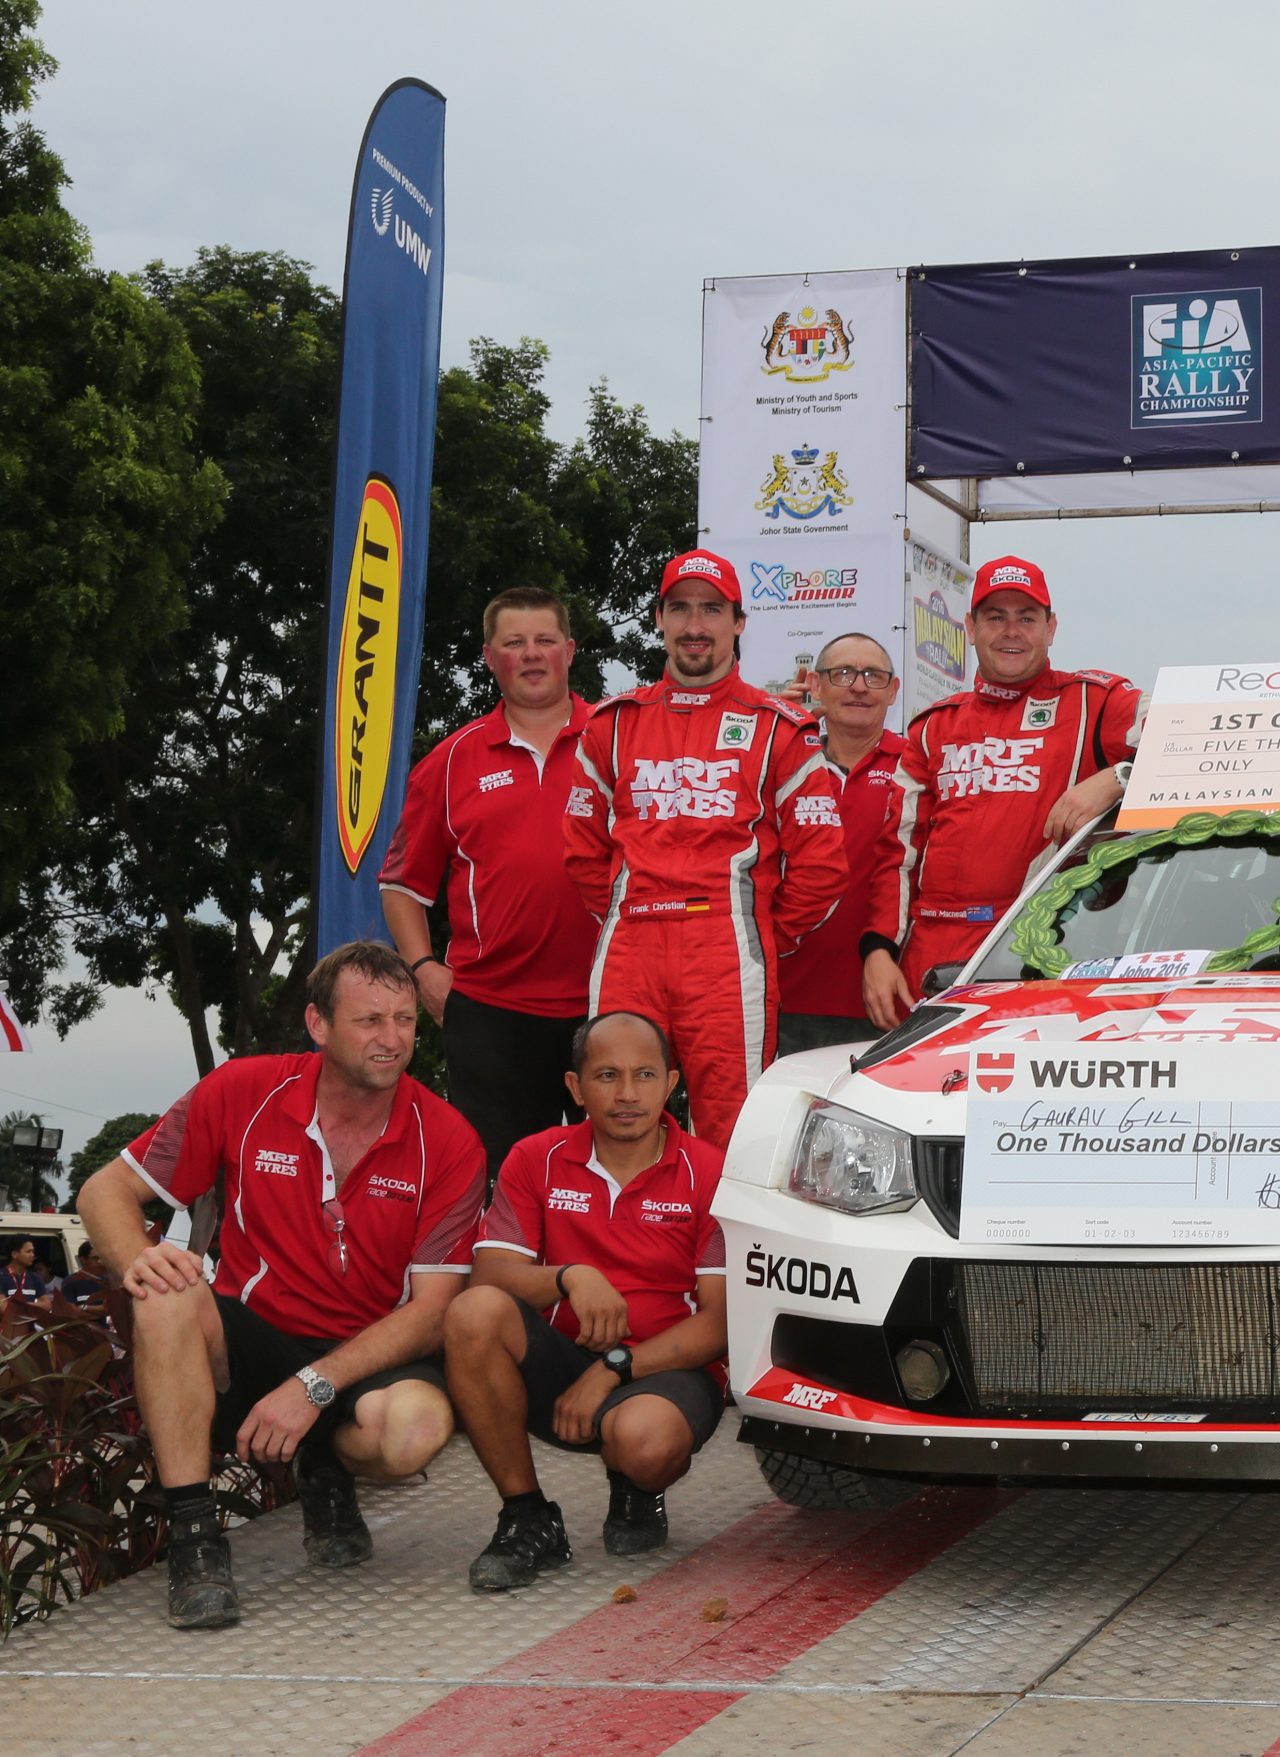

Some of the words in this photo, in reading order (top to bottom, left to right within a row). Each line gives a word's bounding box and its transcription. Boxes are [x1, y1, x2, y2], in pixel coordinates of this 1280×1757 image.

[372, 147, 401, 185] PREMIUM
[401, 173, 425, 210] PRODUCT
[394, 213, 432, 276] UMW
[1142, 354, 1252, 372] ASIA-PACIFIC
[1139, 367, 1254, 399] RALLY
[756, 395, 785, 405] Ministry
[787, 394, 794, 403] of
[795, 393, 817, 403] Youth
[818, 393, 834, 401] and
[834, 391, 858, 403] Sports
[1140, 394, 1250, 411] CHAMPIONSHIP
[772, 407, 801, 416] Ministry
[803, 405, 811, 414] of
[812, 404, 842, 413] Tourism
[760, 527, 781, 536] Johor
[783, 525, 802, 534] State
[803, 523, 849, 533] Government
[788, 587, 856, 602] JOHOR
[931, 596, 945, 615] 2016
[787, 630, 824, 638] Co-Organizer
[915, 603, 965, 673] MALAYSIAN
[348, 522, 389, 829] GRANTT
[670, 692, 710, 706] MRF
[979, 682, 1021, 700] MRF
[1209, 713, 1263, 731] 1ST
[1203, 739, 1248, 753] FIVE
[941, 736, 1044, 774] MRF
[630, 757, 740, 791] MRF
[1198, 759, 1253, 773] ONLY
[480, 777, 515, 793] TYRES
[937, 765, 1041, 801] TYRES
[1149, 787, 1274, 802] MALAYSIAN
[631, 788, 737, 821] TYRES
[629, 903, 649, 914] Frank
[652, 900, 686, 911] Christian
[1137, 952, 1187, 964] 1st
[1119, 964, 1157, 978] Johor
[1156, 963, 1191, 977] 2016
[993, 1120, 1007, 1128] Pay
[1020, 1100, 1106, 1132] GAURAV
[996, 1132, 1048, 1152] One
[1058, 1132, 1185, 1152] Thousand
[255, 1149, 300, 1165] MRF
[255, 1161, 298, 1177] TYRES
[1208, 1156, 1217, 1186] Account
[549, 1187, 592, 1203] MRF
[548, 1199, 590, 1213] TYRES
[986, 1219, 1007, 1227] Cheque
[986, 1229, 1031, 1238] 0000000
[1085, 1229, 1136, 1238] 01-02-03
[1172, 1229, 1230, 1239] 123456789
[745, 1243, 861, 1305] ŠKODA
[782, 1383, 838, 1410] MRF
